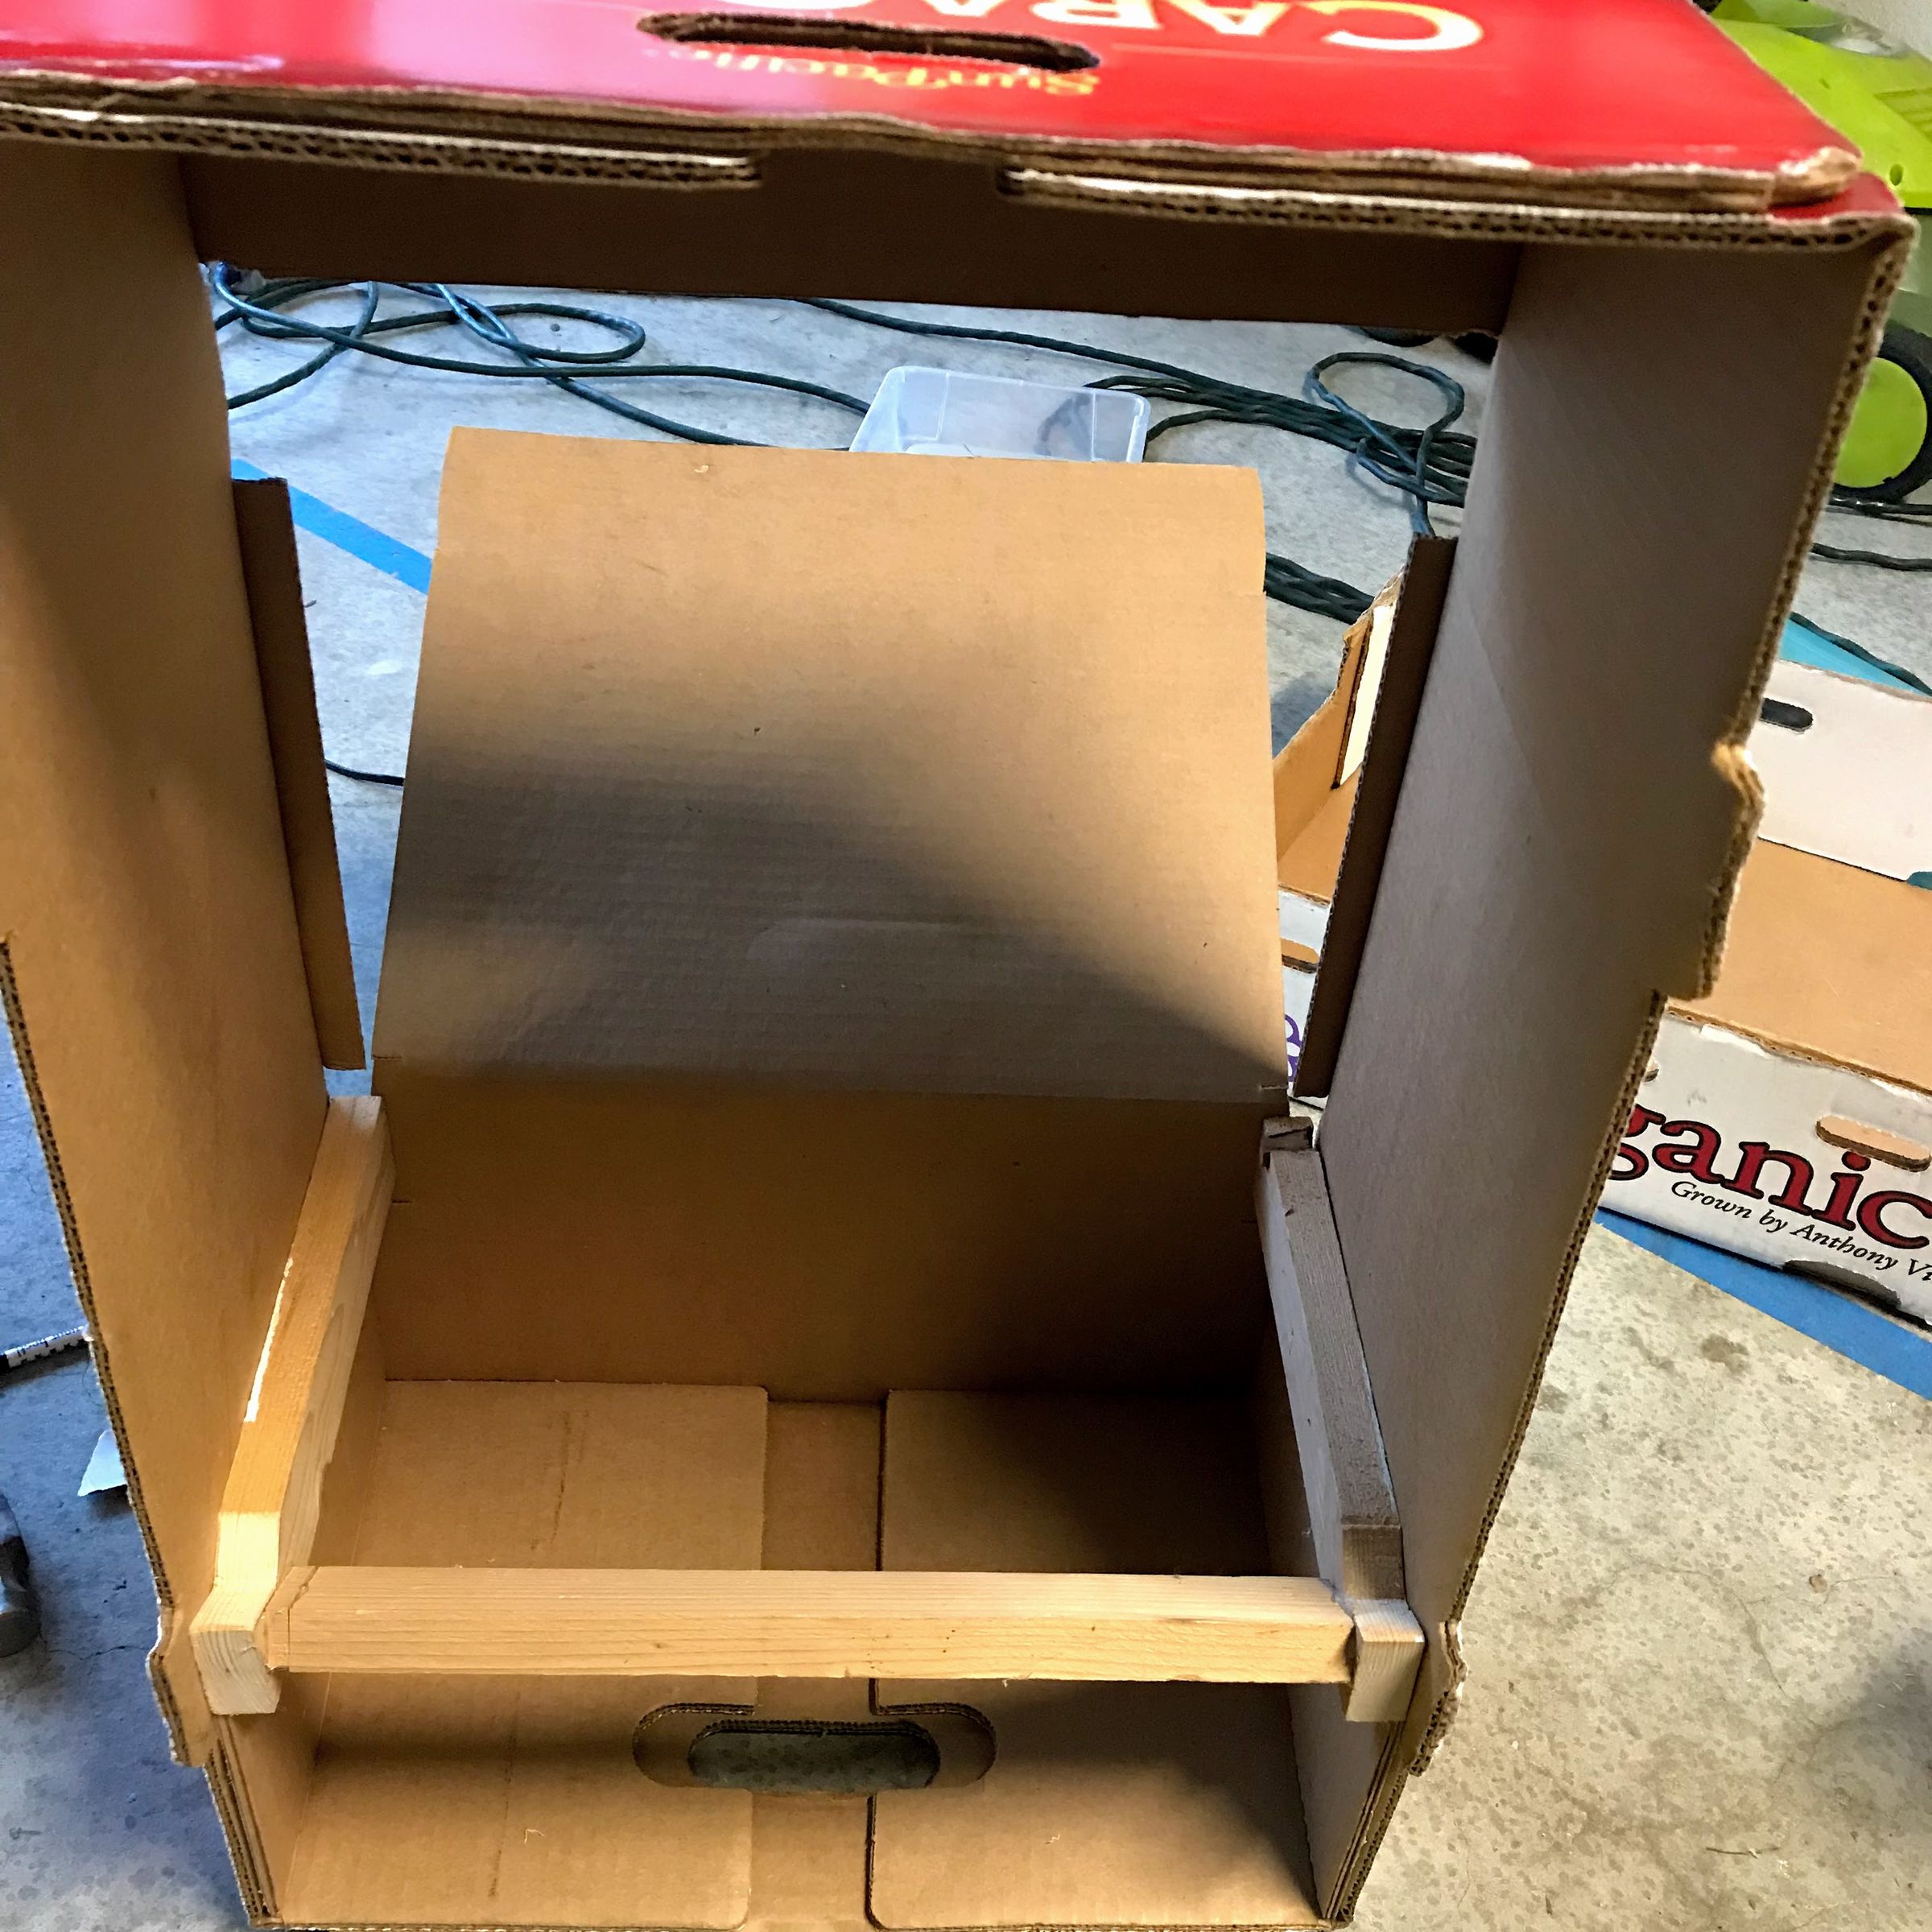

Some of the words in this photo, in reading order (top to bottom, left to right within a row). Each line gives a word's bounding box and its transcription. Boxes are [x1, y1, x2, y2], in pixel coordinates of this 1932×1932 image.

[1671, 1180, 1752, 1219] Grown
[1758, 1209, 1789, 1234] by
[1789, 1224, 1898, 1269] Anthony
